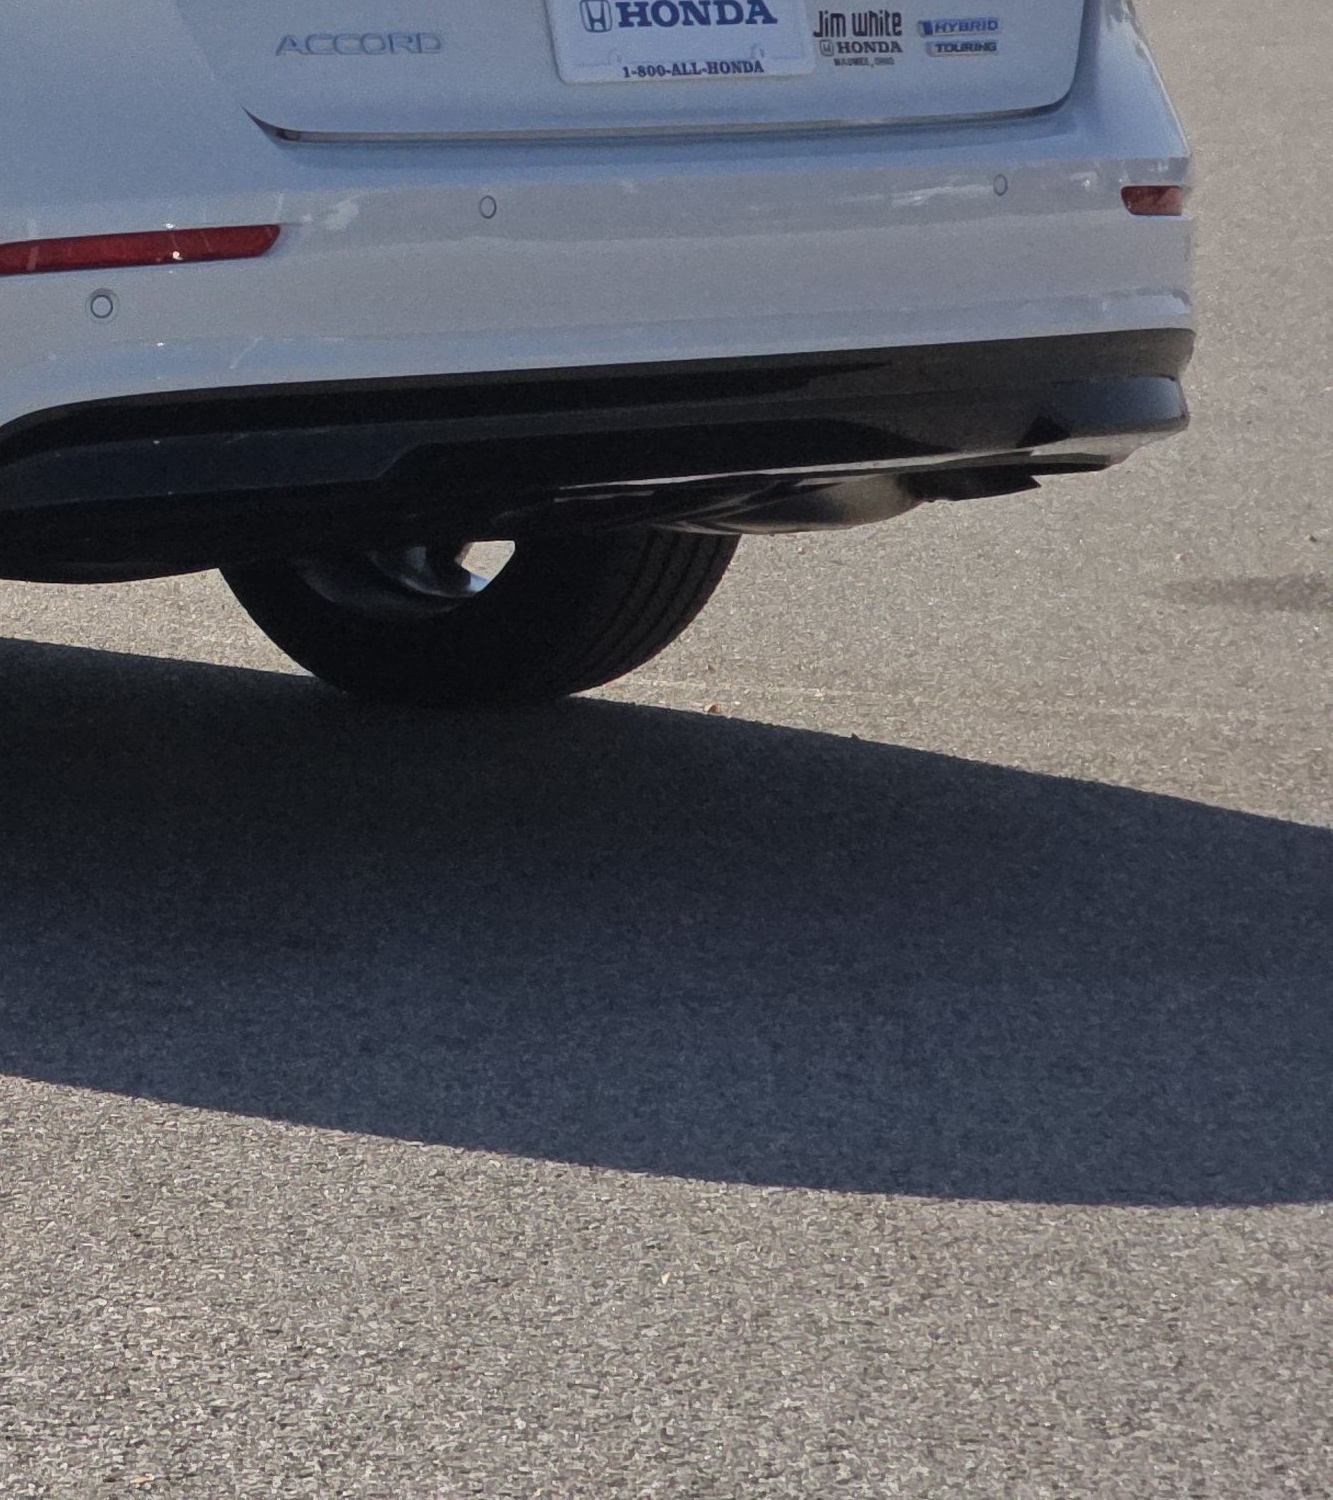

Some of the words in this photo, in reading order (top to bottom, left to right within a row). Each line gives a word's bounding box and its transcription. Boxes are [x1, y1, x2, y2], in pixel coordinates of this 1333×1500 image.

[615, 0, 778, 28] HONDA
[813, 9, 846, 37] Jim
[934, 19, 998, 33] HYBRID
[275, 32, 444, 56] ACCORD
[837, 41, 903, 54] HONDA
[935, 40, 998, 54] TOURING
[623, 60, 765, 78] 1-800-ALL-HONDA
